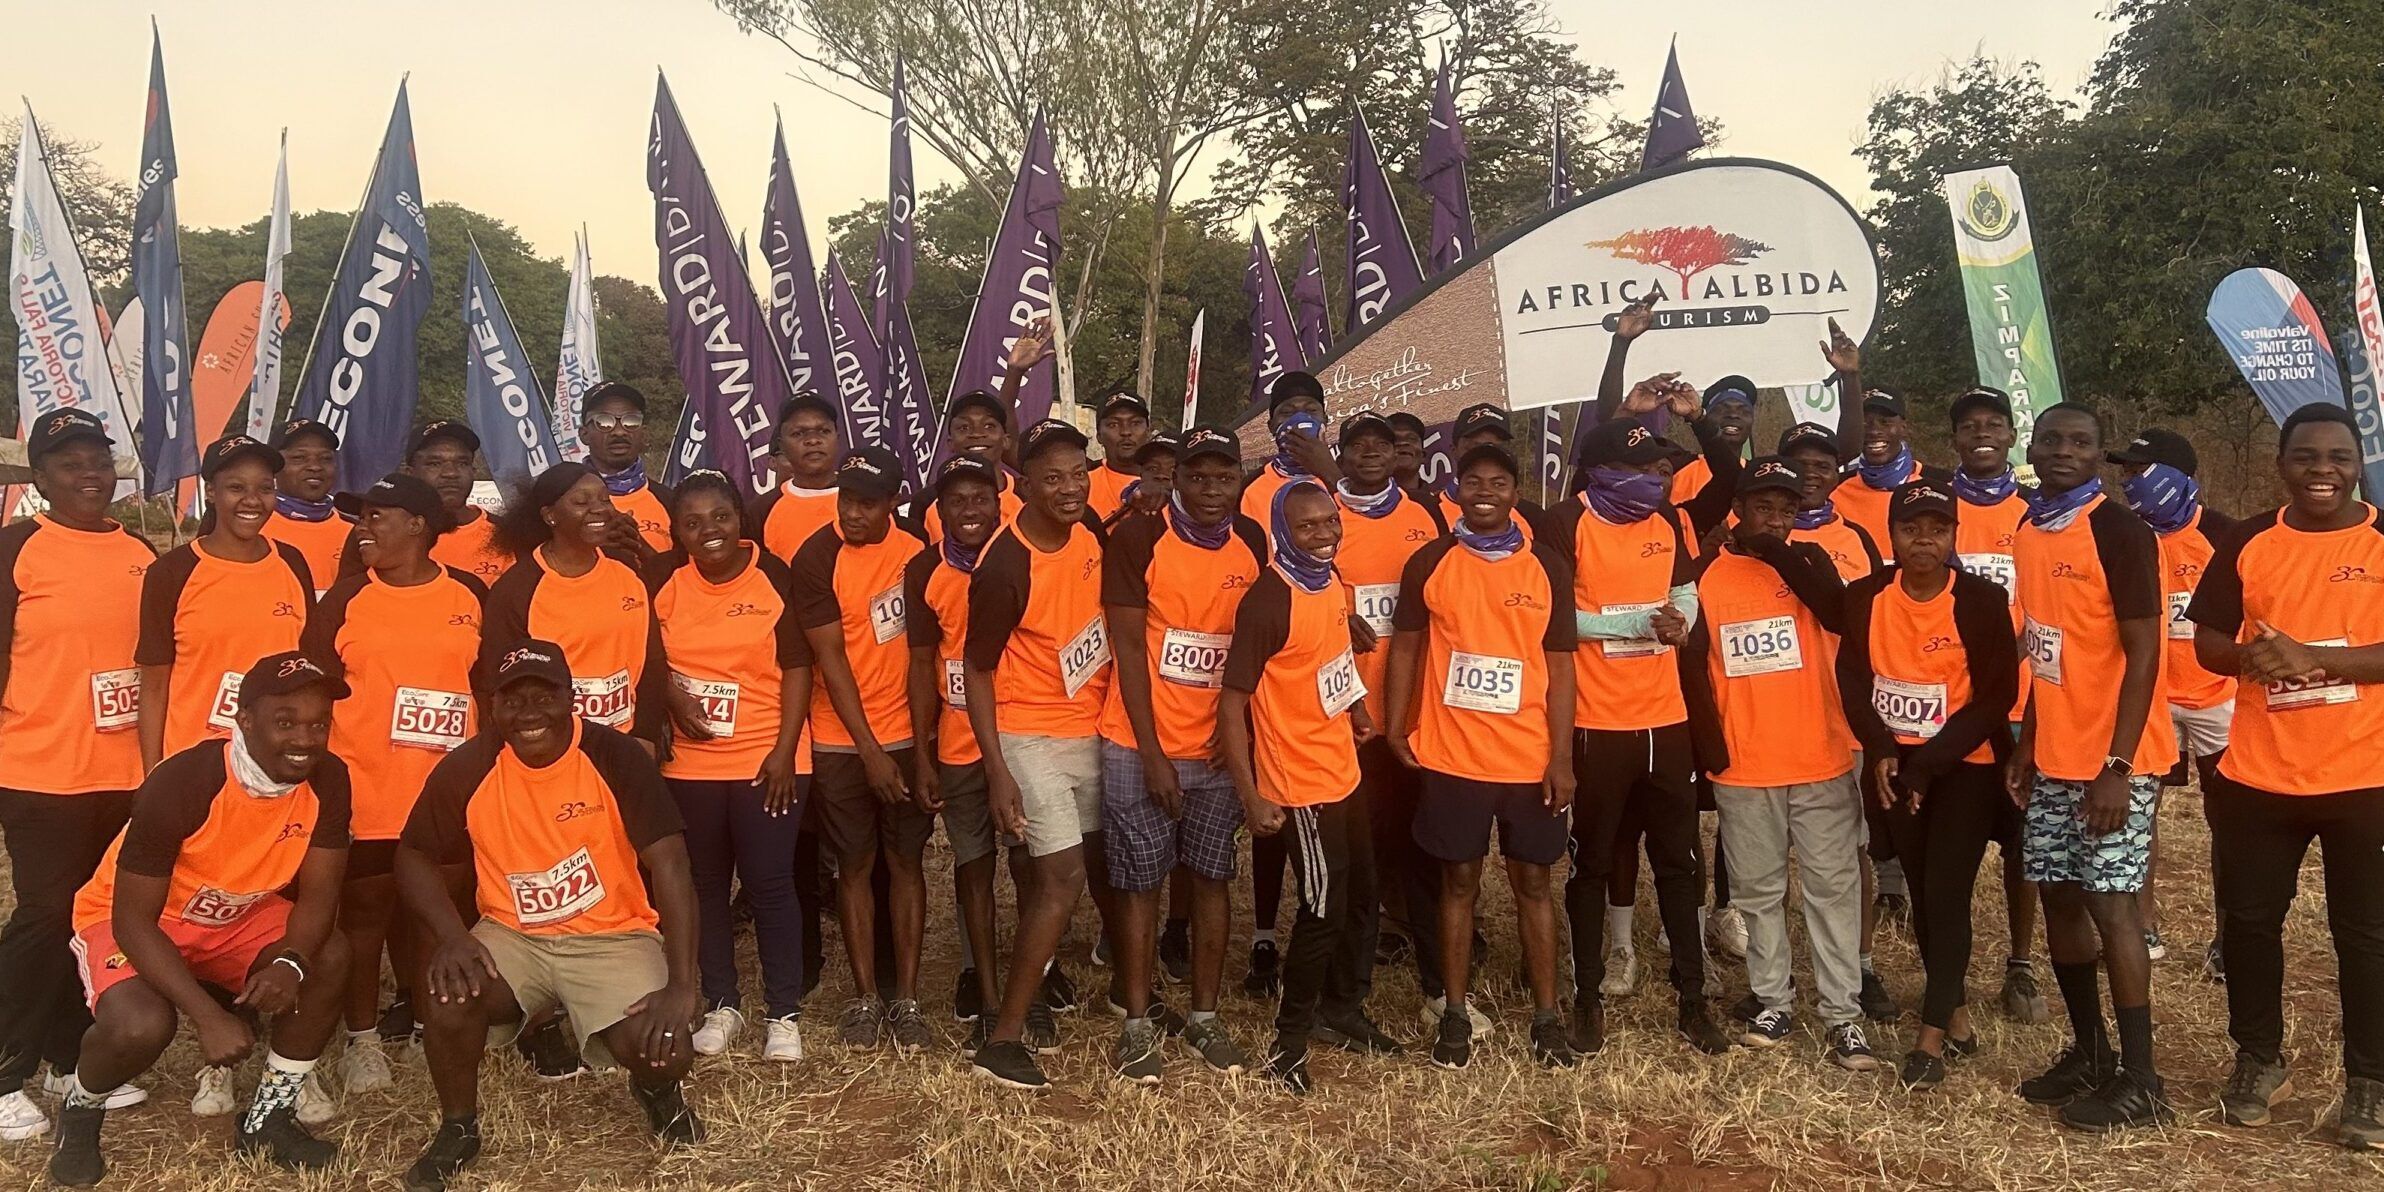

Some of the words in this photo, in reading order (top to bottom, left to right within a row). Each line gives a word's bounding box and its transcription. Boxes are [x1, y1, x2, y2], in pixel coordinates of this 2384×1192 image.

[1517, 277, 1669, 314] AFRICA
[1703, 269, 1848, 300] ALBIDA
[1613, 310, 1759, 328] URISM
[1170, 629, 1206, 641] STEWARD
[1768, 619, 1793, 629] 21km
[2038, 627, 2061, 639] 21km
[1065, 629, 1103, 678] 1023
[1167, 644, 1229, 671] 8002
[1729, 630, 1792, 658] 1036
[1454, 665, 1514, 693] 1035
[1496, 660, 1521, 670] 21km
[606, 675, 629, 692] 7.5km
[701, 684, 737, 697] 7.5km
[572, 689, 626, 717] 5011
[1876, 690, 1940, 720] 8007
[399, 706, 463, 736] 5028
[551, 852, 587, 881] 7.5km
[520, 868, 594, 913] 5022
